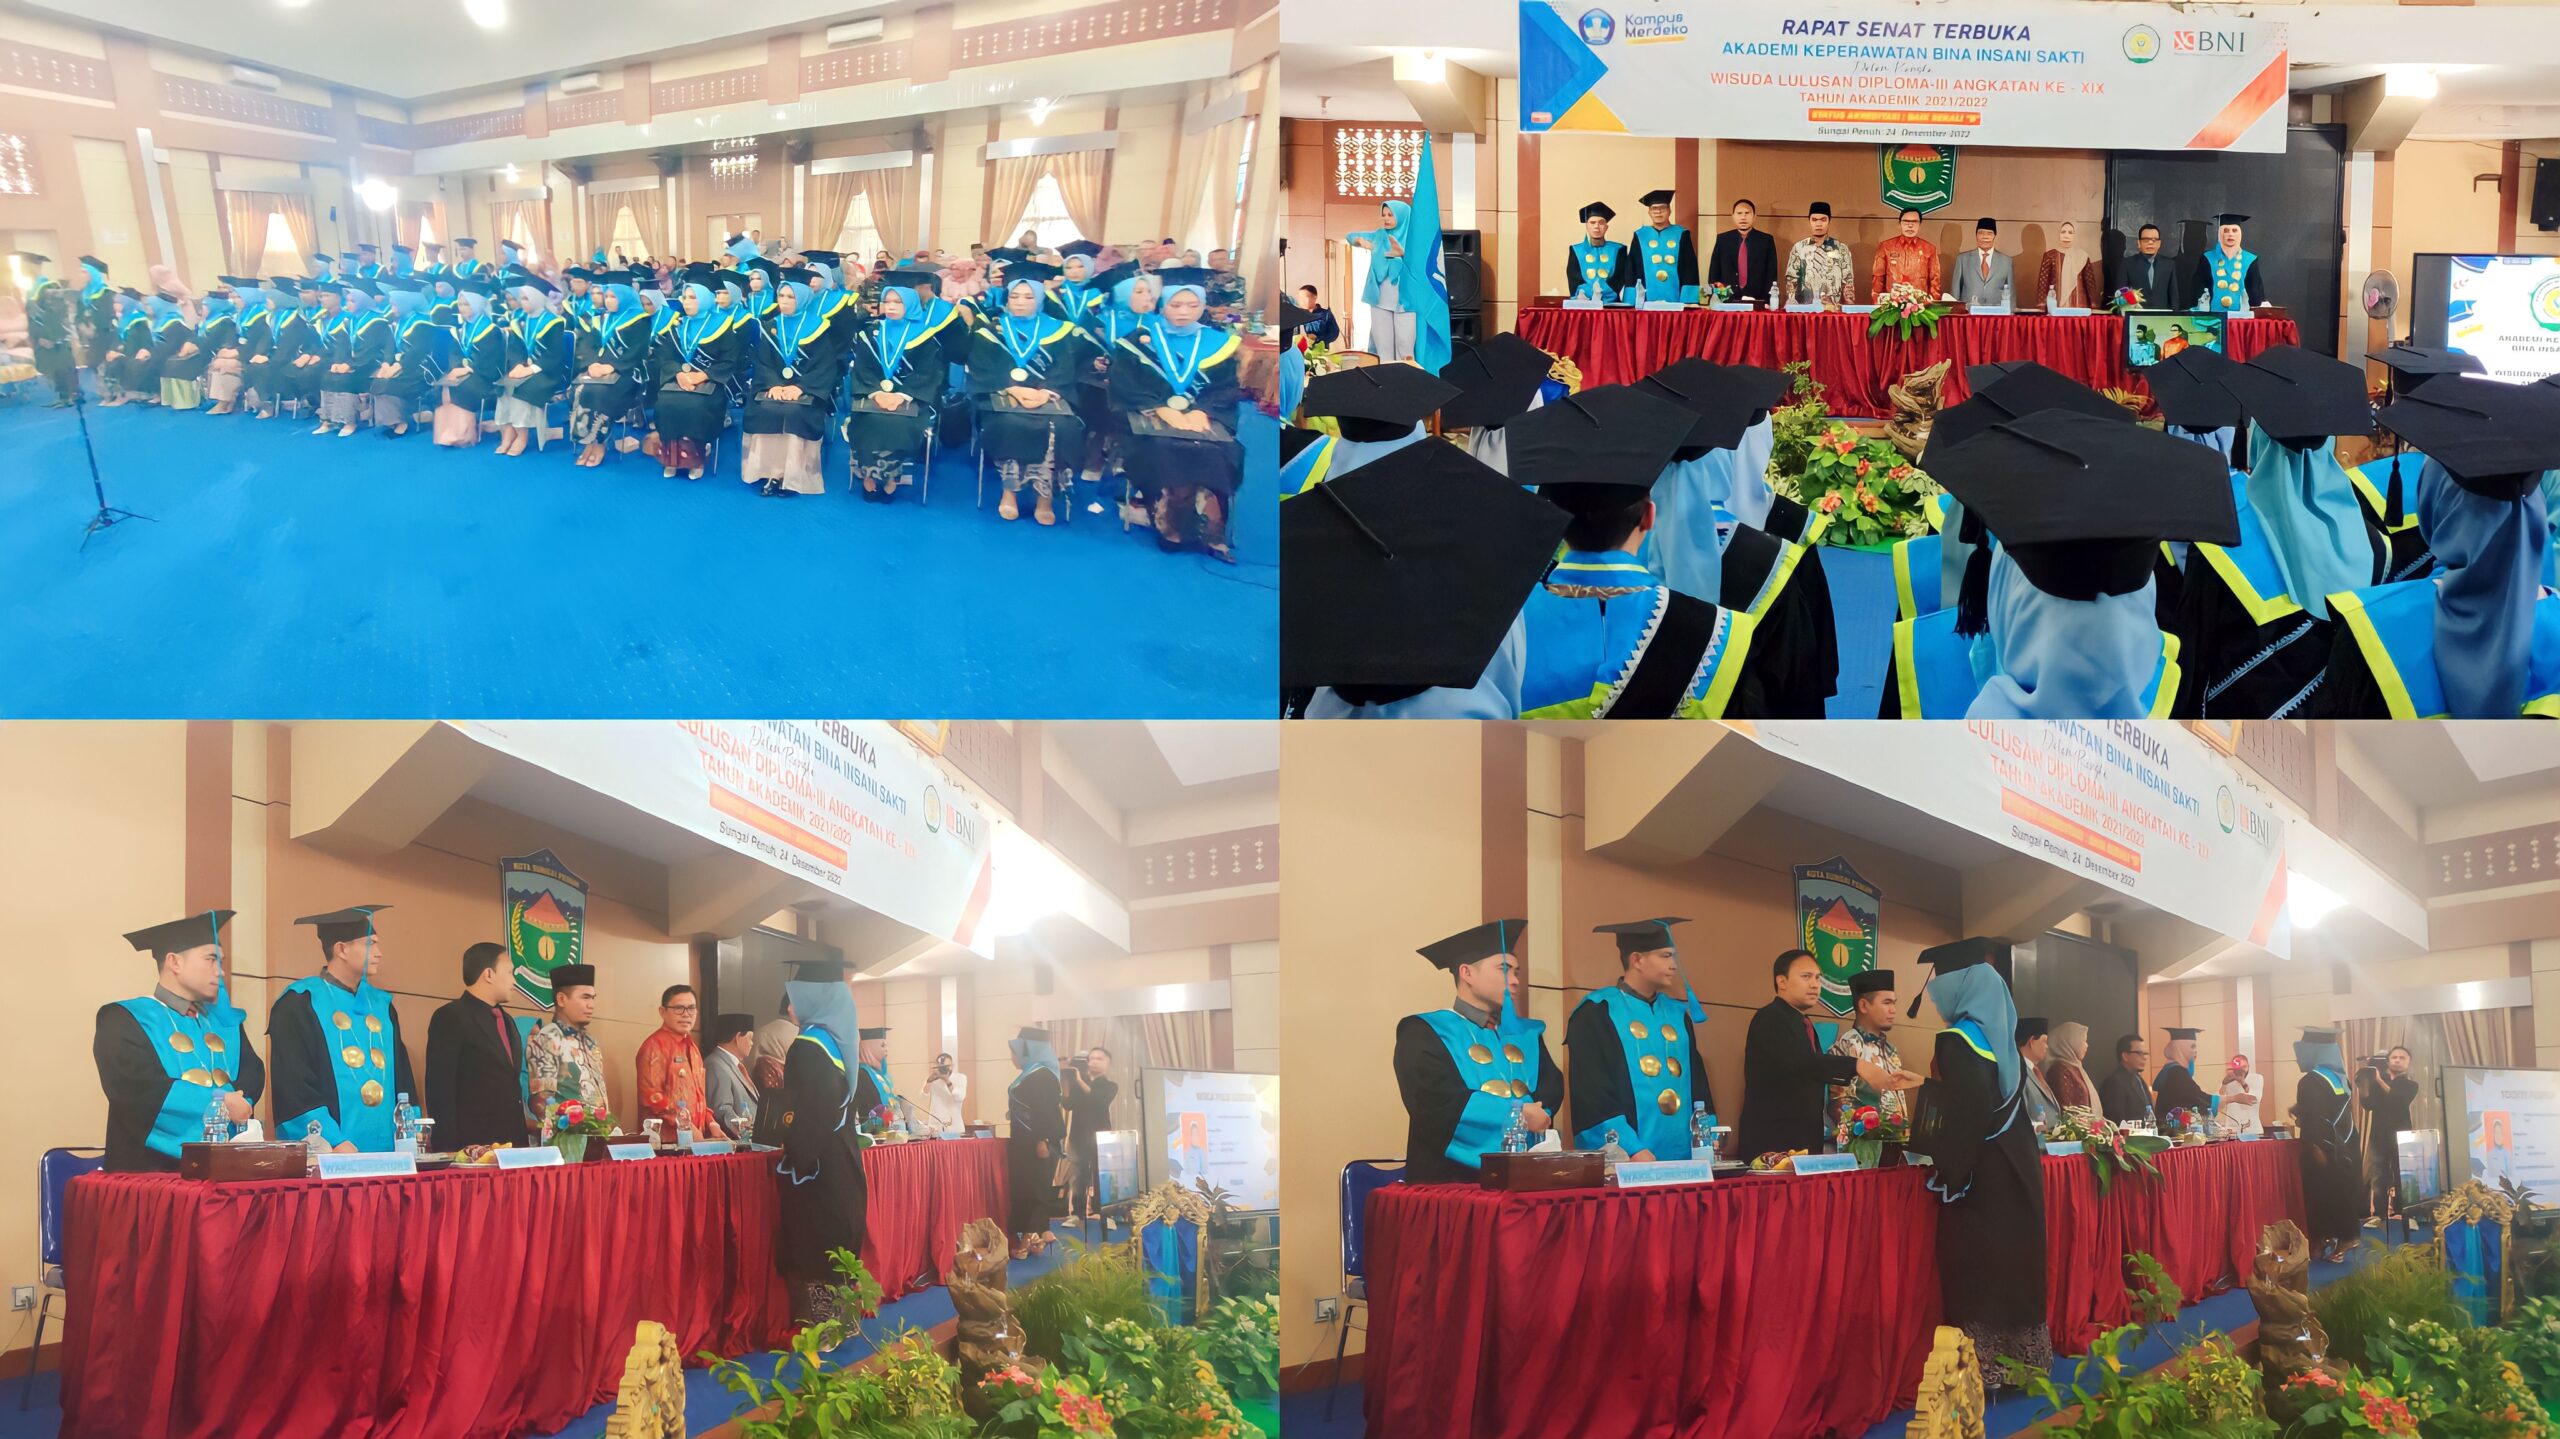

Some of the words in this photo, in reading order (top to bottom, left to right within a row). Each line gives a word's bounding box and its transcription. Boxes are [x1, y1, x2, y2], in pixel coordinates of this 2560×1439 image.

[1625, 13, 1684, 26] Kampus
[1625, 24, 1689, 38] Merdeka
[1782, 19, 1850, 36] RAPAT
[1856, 21, 1926, 38] SENAT
[1933, 23, 2031, 41] TERBUKA
[1722, 42, 1798, 56] AKADEMI
[1804, 44, 1928, 59] KEPERAWATAN
[1933, 47, 1972, 61] BINA
[1976, 49, 2031, 62] INSANI
[2037, 50, 2085, 64] SAKTI
[2198, 31, 2245, 53] BNI
[1710, 72, 1774, 86] WISUDA
[1778, 73, 1853, 87] LULUSAN
[1858, 75, 1948, 90] DIPLOMA-III
[1953, 79, 2040, 93] ANGKATAN
[2045, 81, 2065, 93] KE
[2081, 82, 2105, 94] XIX
[1799, 92, 1845, 104] TAHUN
[1849, 93, 1920, 106] AKADEMIK
[1925, 95, 1988, 107] 2021/2022
[1818, 127, 1849, 137] Sungai
[698, 747, 745, 791] TAHUN
[748, 776, 806, 822] AKADEMIK
[1990, 752, 2036, 793] TAHUN
[2040, 780, 2098, 825] AKADEMIK
[2106, 742, 2134, 776] BINA
[2136, 762, 2171, 799] INSANI
[2173, 785, 2200, 817] SAKTI
[880, 784, 906, 817] SAKTI
[719, 820, 749, 844] Sungai
[828, 796, 884, 844] ANGKATAN
[955, 809, 975, 846] BNI
[2249, 809, 2269, 847] BNI
[2011, 824, 2042, 848] Sungai
